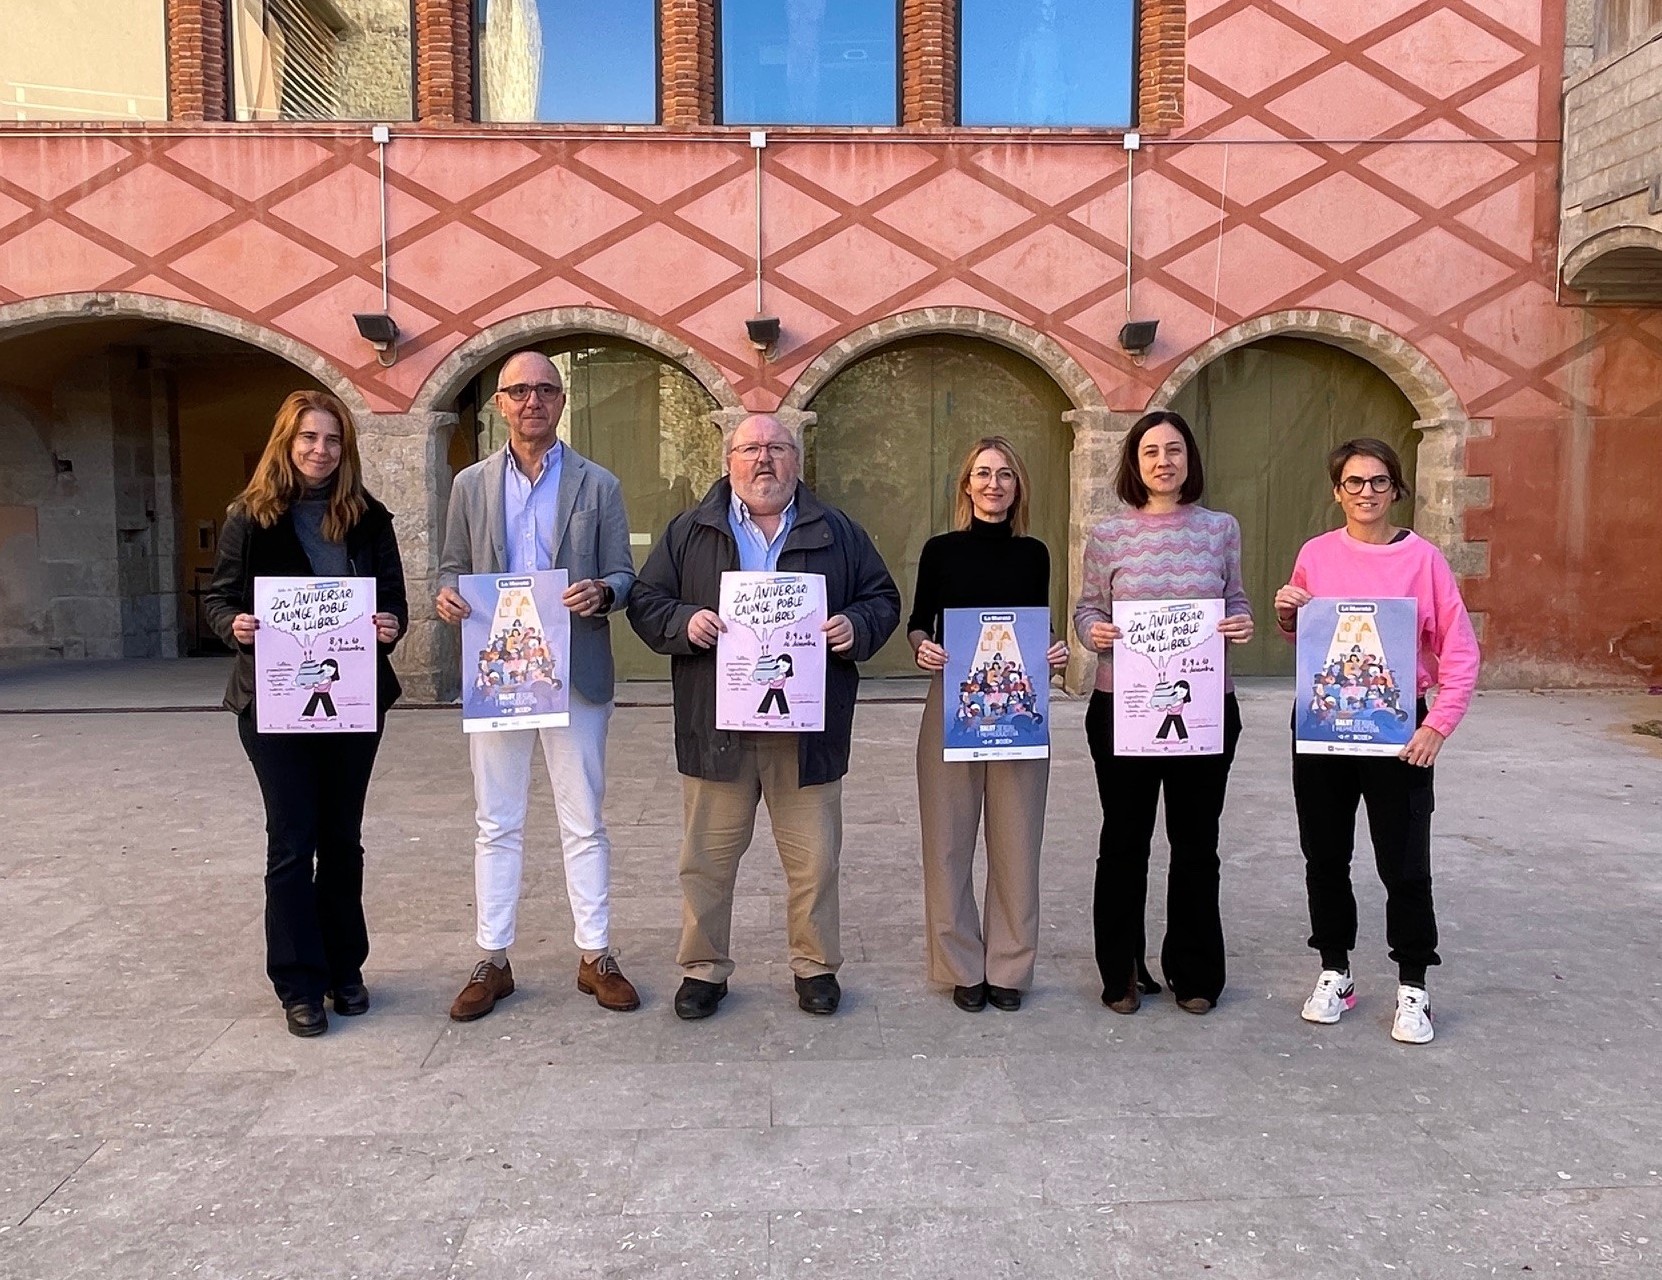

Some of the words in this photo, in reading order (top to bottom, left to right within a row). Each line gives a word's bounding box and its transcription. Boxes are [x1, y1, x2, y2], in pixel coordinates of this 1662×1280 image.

[271, 597, 290, 610] 2n
[293, 589, 353, 607] ANIVERSARI
[733, 591, 751, 603] 2n
[753, 584, 807, 602] ANIVERSARI
[319, 600, 348, 615] POBLE
[777, 596, 803, 610] POBLE
[291, 622, 301, 631] de
[304, 615, 339, 631] LLIBRES
[751, 616, 759, 624] de
[763, 610, 795, 624] LLIBRES
[1127, 620, 1146, 632] 2n
[1149, 610, 1205, 630] ANIVERSARI
[1172, 622, 1199, 638] POBLE
[1147, 644, 1156, 652] de
[1159, 636, 1191, 652] LLIBRES
